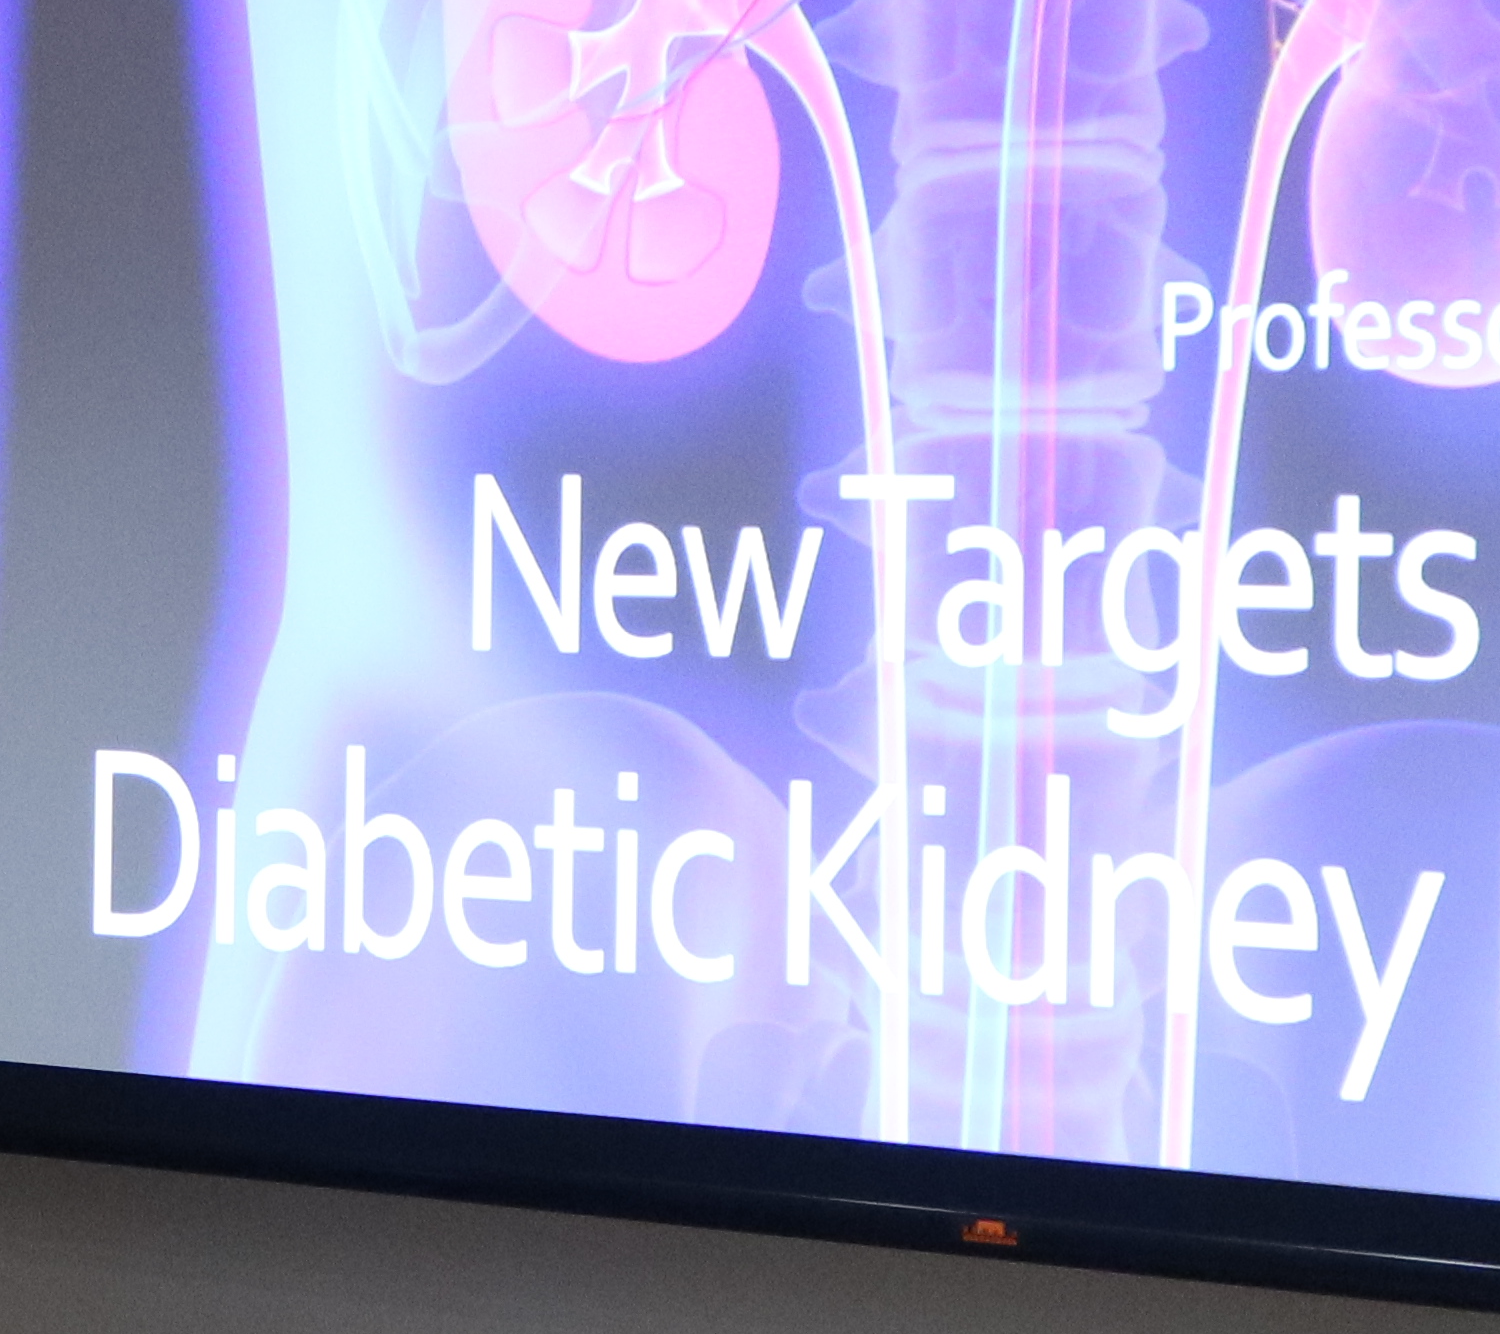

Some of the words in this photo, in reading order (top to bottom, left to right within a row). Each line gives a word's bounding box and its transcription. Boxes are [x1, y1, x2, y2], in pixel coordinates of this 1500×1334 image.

[470, 472, 823, 661] New
[839, 473, 1479, 739] Targets
[91, 744, 735, 982] Diabetic
[785, 773, 1445, 1102] Kidney
